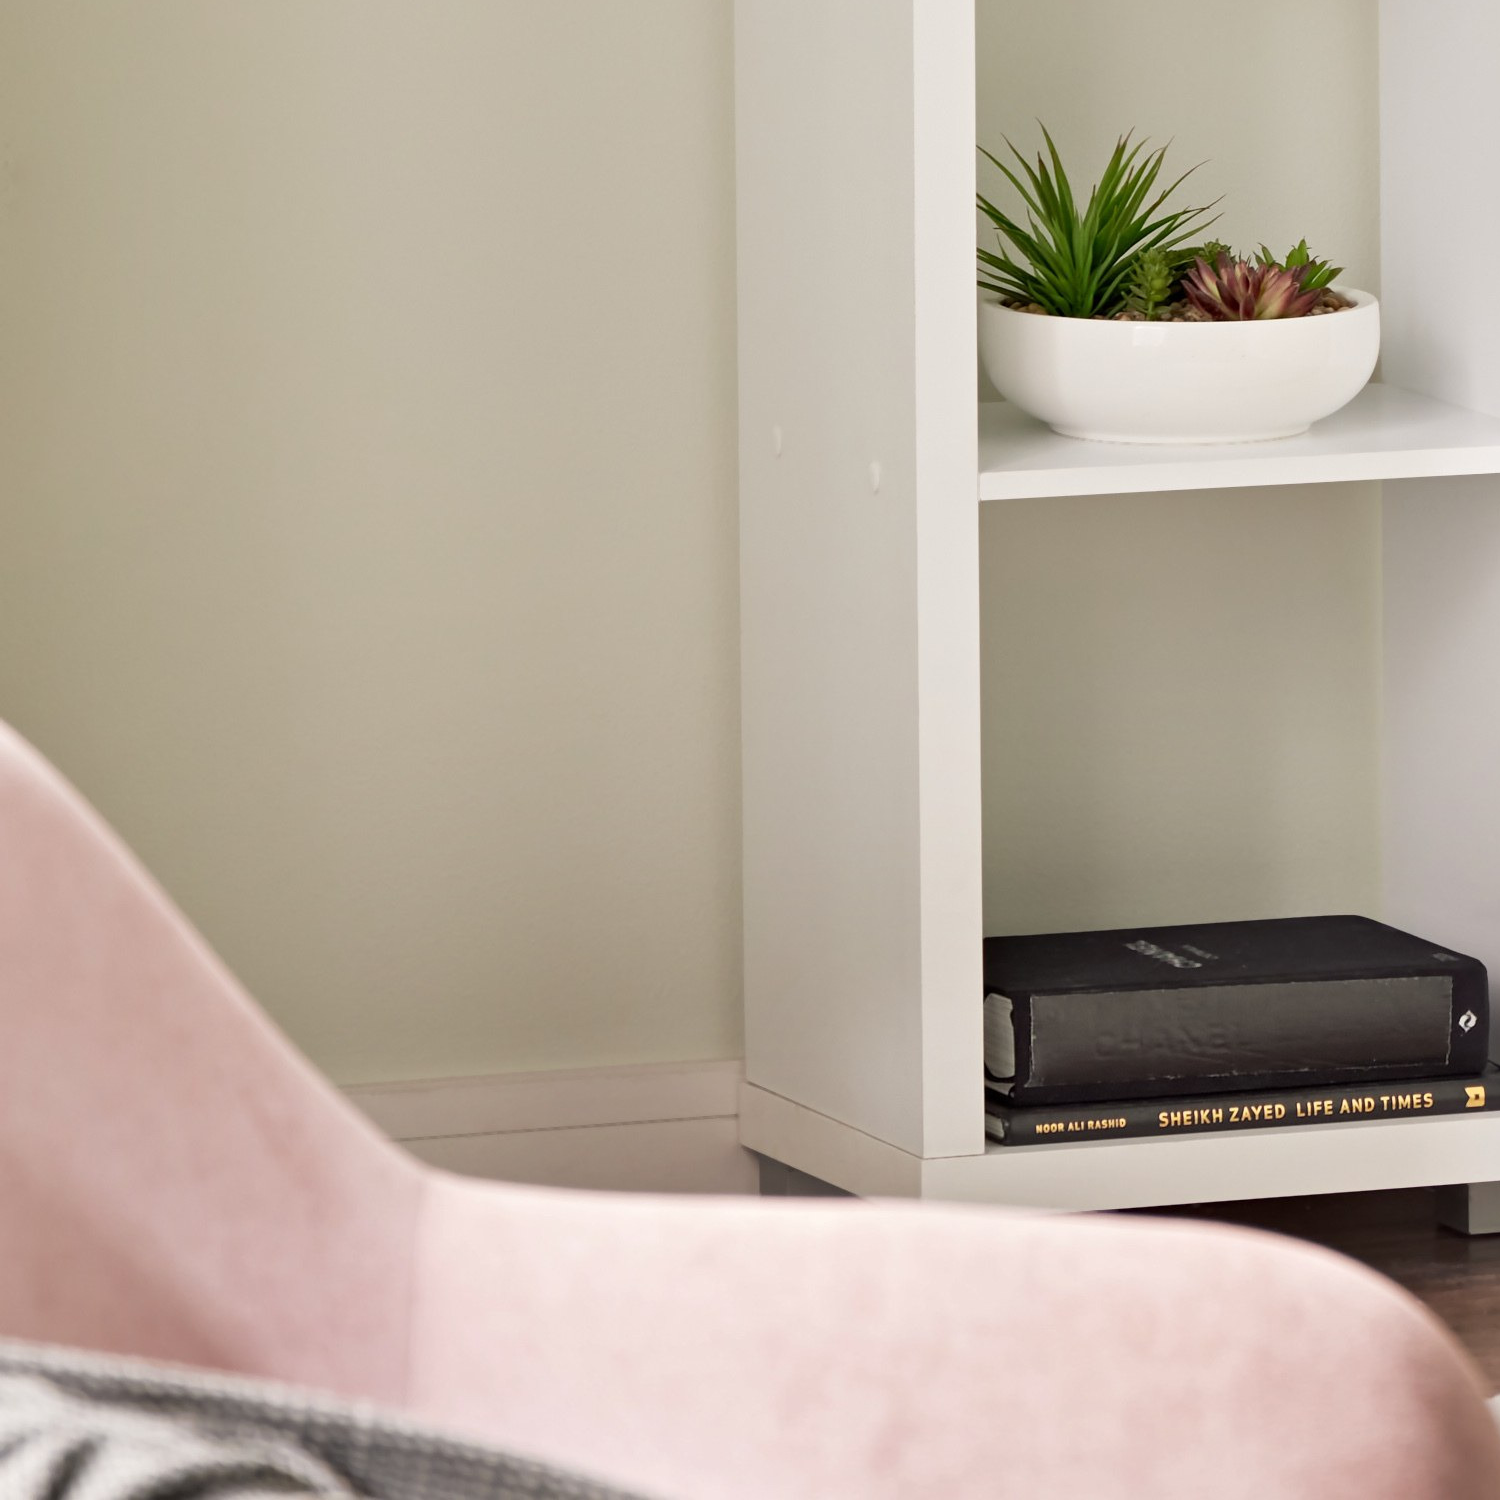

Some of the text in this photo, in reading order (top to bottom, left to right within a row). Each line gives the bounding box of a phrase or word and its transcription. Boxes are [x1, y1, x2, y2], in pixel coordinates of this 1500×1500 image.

[1159, 1093, 1433, 1127] SHEIKH ZAYED LIFE AND TIMES
[1036, 1118, 1127, 1133] NOOR ALI RASHID
